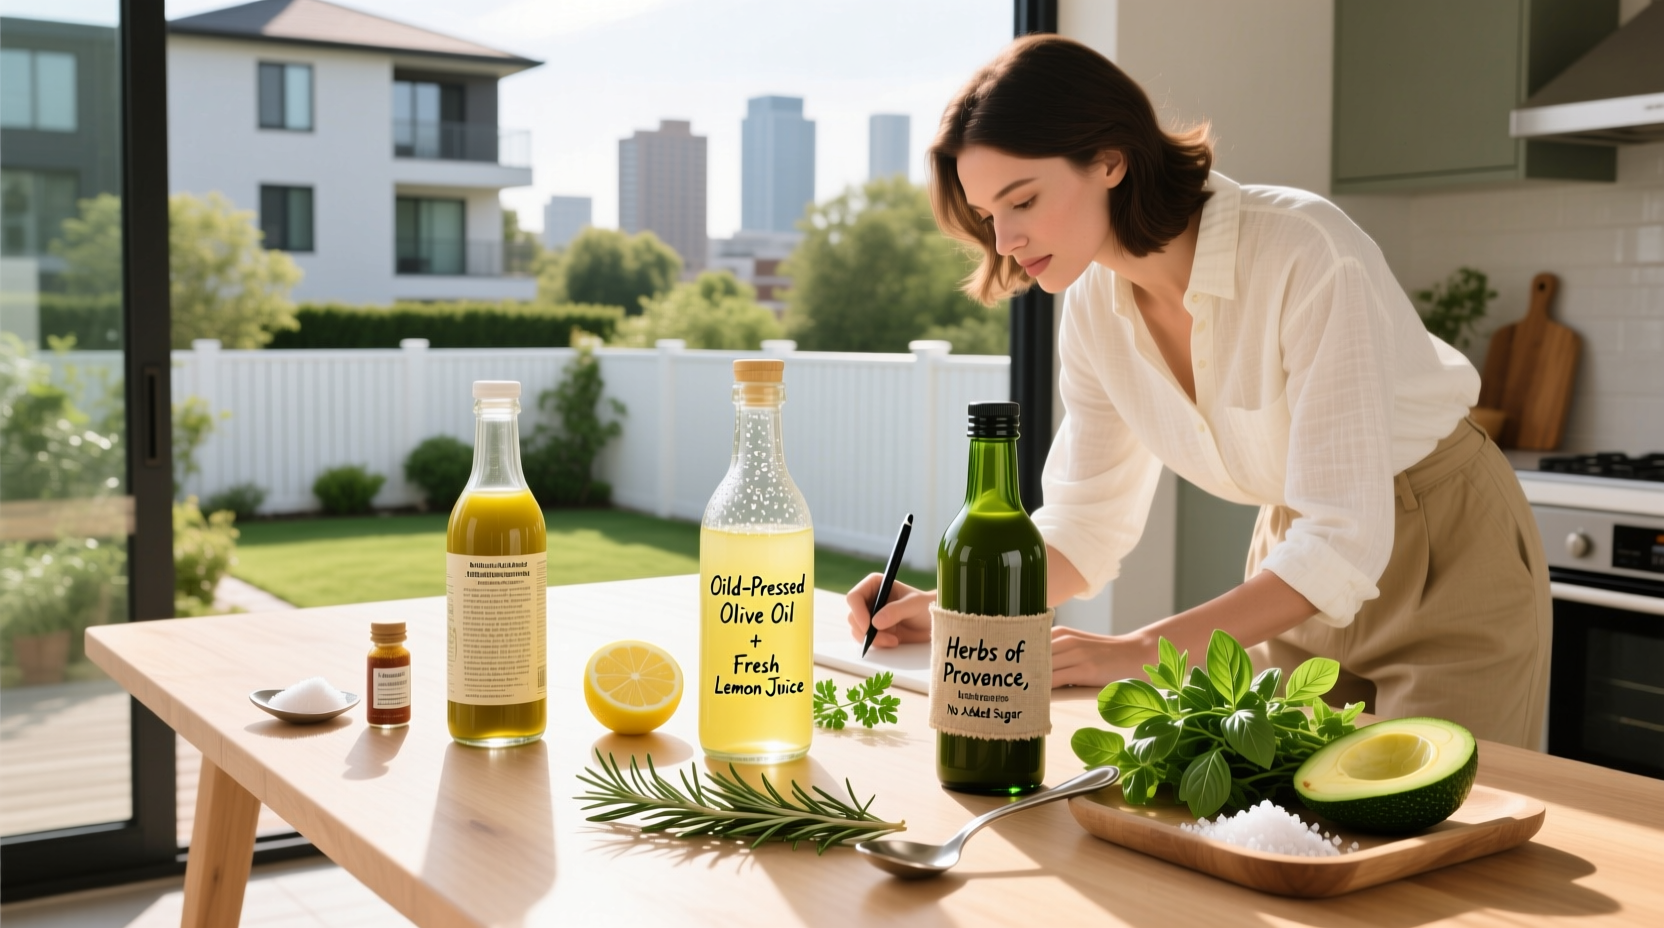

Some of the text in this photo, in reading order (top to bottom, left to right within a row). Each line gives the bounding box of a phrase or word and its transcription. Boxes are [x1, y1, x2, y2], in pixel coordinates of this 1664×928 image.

[710, 573, 806, 597] Oild-Pressed
[720, 601, 795, 624] Olive Oil
[750, 634, 762, 648] +
[946, 636, 1026, 664] Herbs of
[734, 654, 780, 675] Fresh
[714, 675, 805, 697] Lemon Juice
[993, 708, 1023, 724] Sugar
